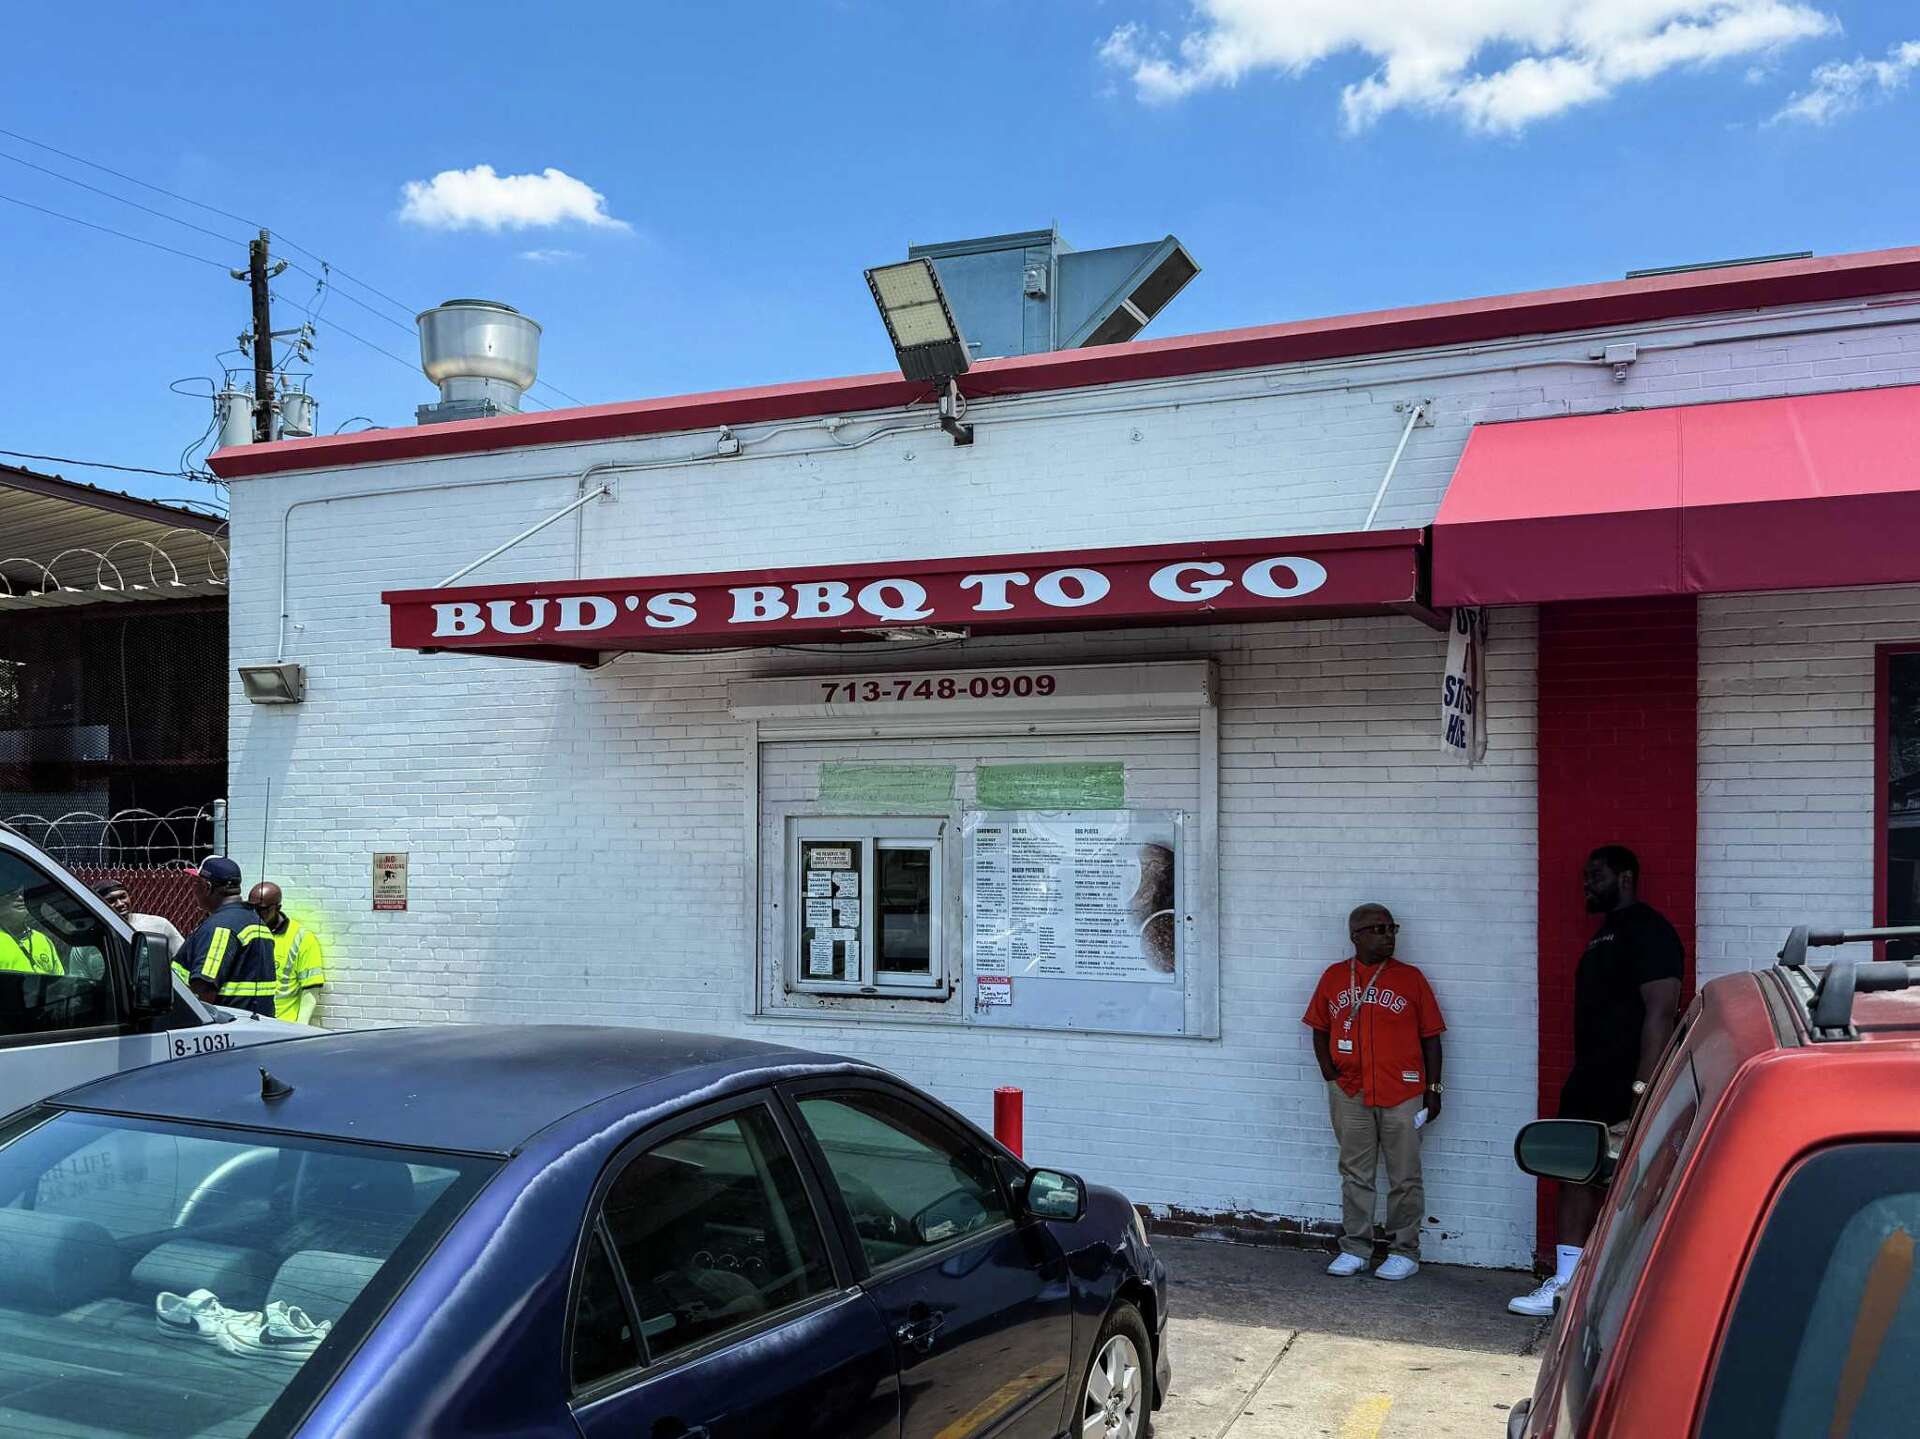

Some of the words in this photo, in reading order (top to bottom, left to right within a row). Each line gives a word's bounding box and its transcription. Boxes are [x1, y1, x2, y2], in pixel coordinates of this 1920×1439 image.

[431, 592, 698, 638] BUD'S
[727, 578, 935, 624] BBQ
[959, 568, 1112, 611] TO
[1148, 556, 1328, 602] GO
[820, 675, 1057, 703] 713-748-0909
[1328, 986, 1408, 1018] ASTROS
